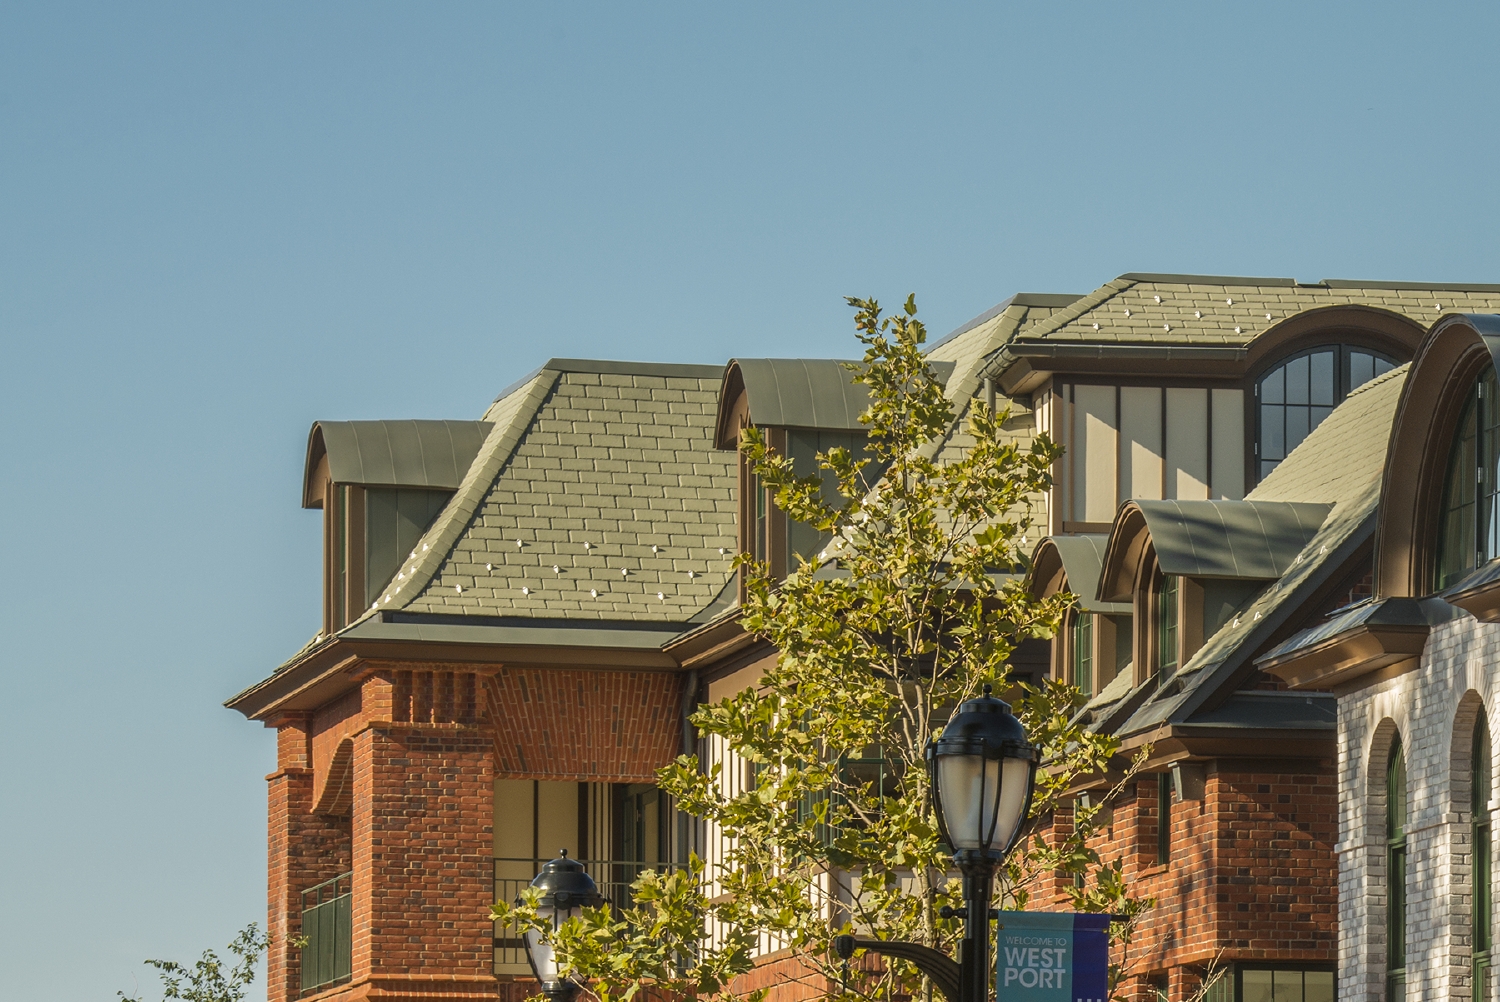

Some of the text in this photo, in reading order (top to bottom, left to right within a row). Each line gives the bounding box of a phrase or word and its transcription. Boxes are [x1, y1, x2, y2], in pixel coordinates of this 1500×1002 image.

[1005, 936, 1067, 947] WELCOME TO
[1004, 947, 1066, 968] WEST
[1004, 968, 1066, 989] PORT
